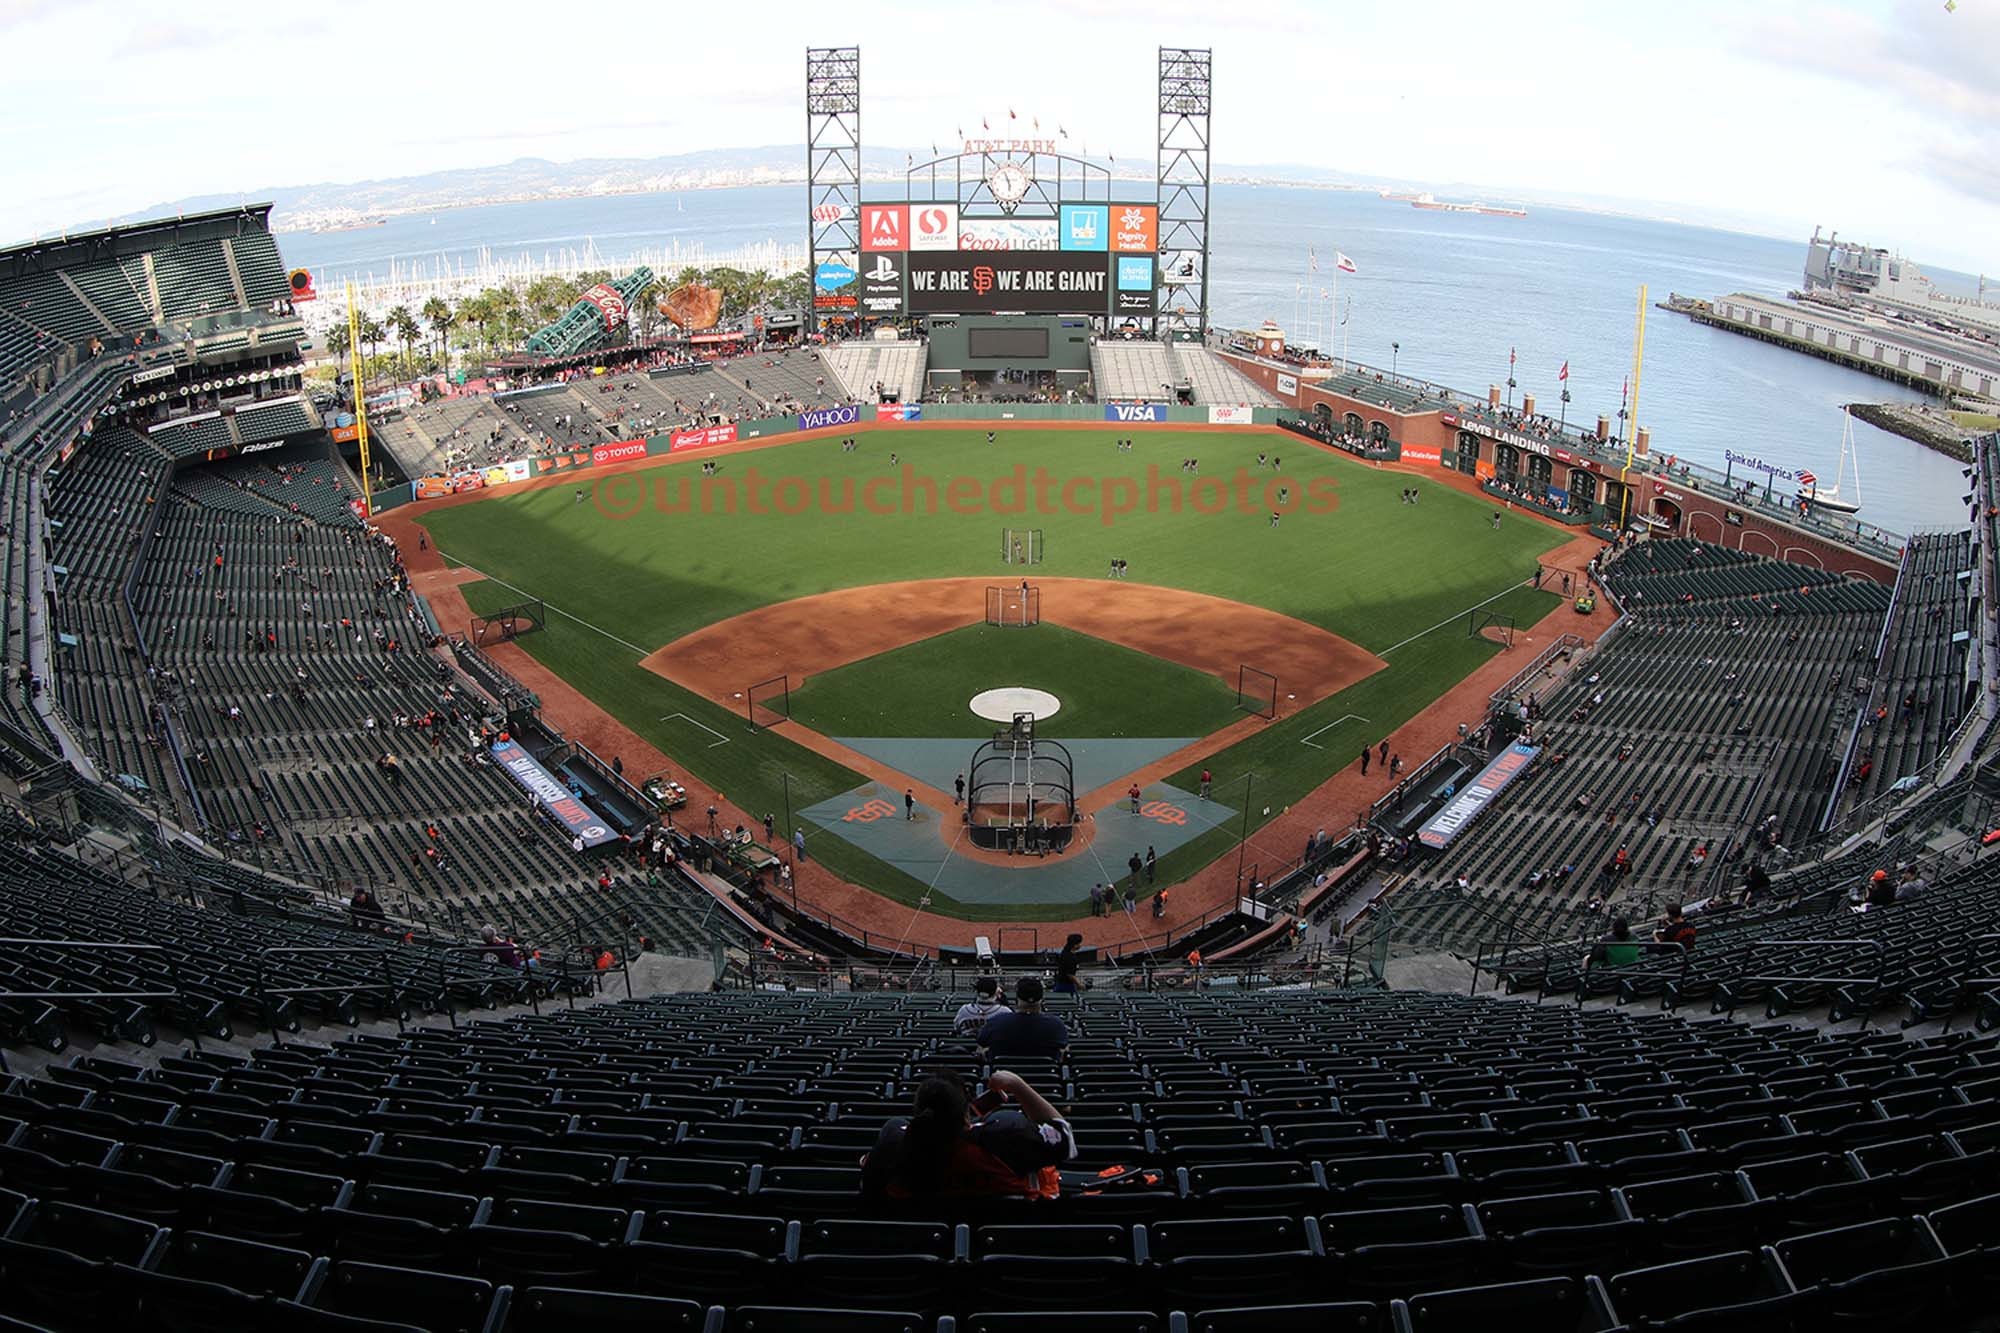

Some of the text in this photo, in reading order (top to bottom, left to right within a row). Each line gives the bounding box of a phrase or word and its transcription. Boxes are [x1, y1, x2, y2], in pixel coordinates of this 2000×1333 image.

[963, 140, 1056, 153] AT&T PARK
[871, 236, 899, 247] Adobe
[1117, 231, 1148, 243] Dignity
[1013, 239, 1059, 250] LIGHT
[1119, 242, 1147, 250] Health
[911, 271, 936, 291] WE
[939, 271, 970, 291] ARE
[997, 271, 1021, 291] WE
[1024, 271, 1055, 291] ARE
[1059, 271, 1106, 291] GIANT
[802, 407, 857, 429] YAHOO!
[1115, 406, 1156, 421] VISA
[1495, 429, 1550, 456] LANDING
[609, 444, 646, 458] TOYOTA
[1724, 449, 1793, 481] Bank of America
[1429, 795, 1483, 834] WELCOME
[1467, 786, 1493, 799] TO
